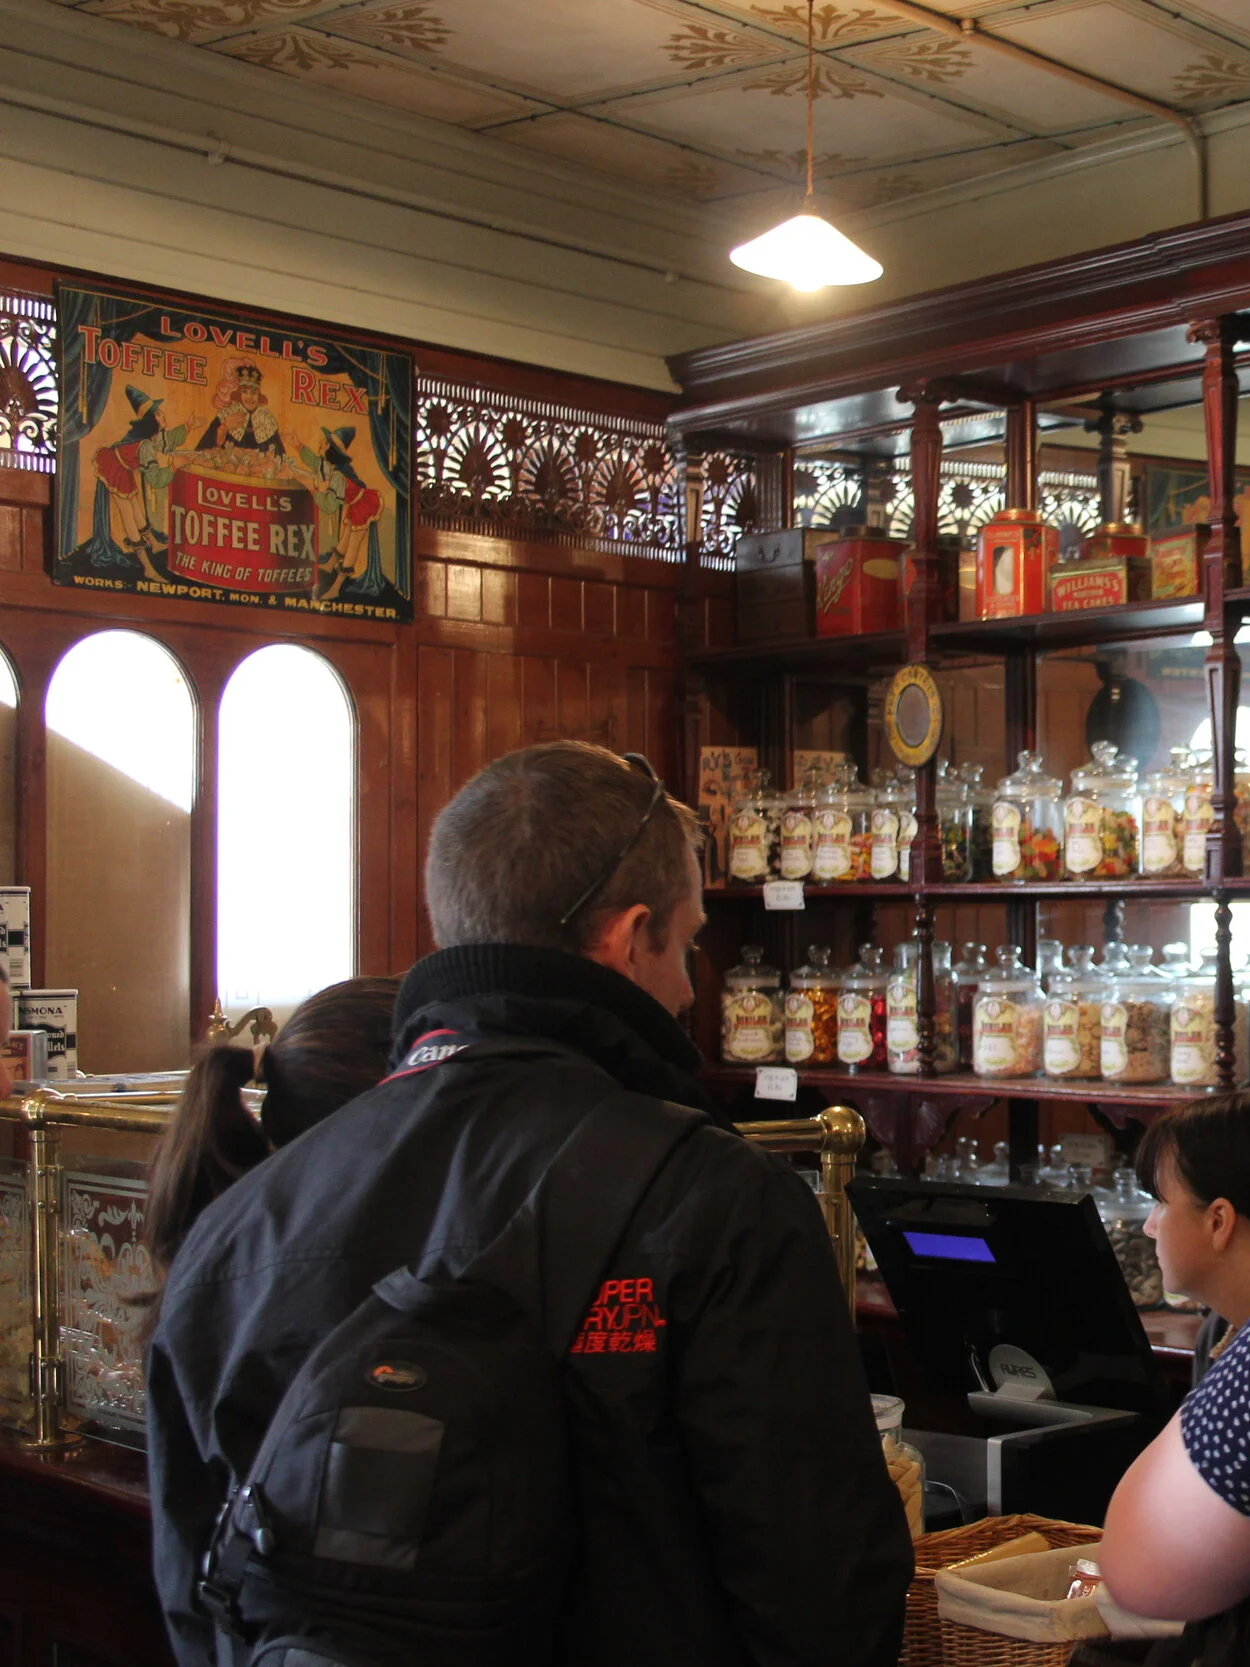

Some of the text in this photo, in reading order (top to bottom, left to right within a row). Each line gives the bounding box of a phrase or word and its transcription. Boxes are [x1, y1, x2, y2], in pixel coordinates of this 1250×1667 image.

[161, 316, 329, 367] LOVELL'S
[78, 325, 370, 416] TOFFEE REX
[197, 480, 292, 512] LOVELL'S
[171, 504, 317, 563] TOFFEE REX
[175, 551, 313, 584] THE KING OF TOFFEES
[268, 593, 277, 605] &
